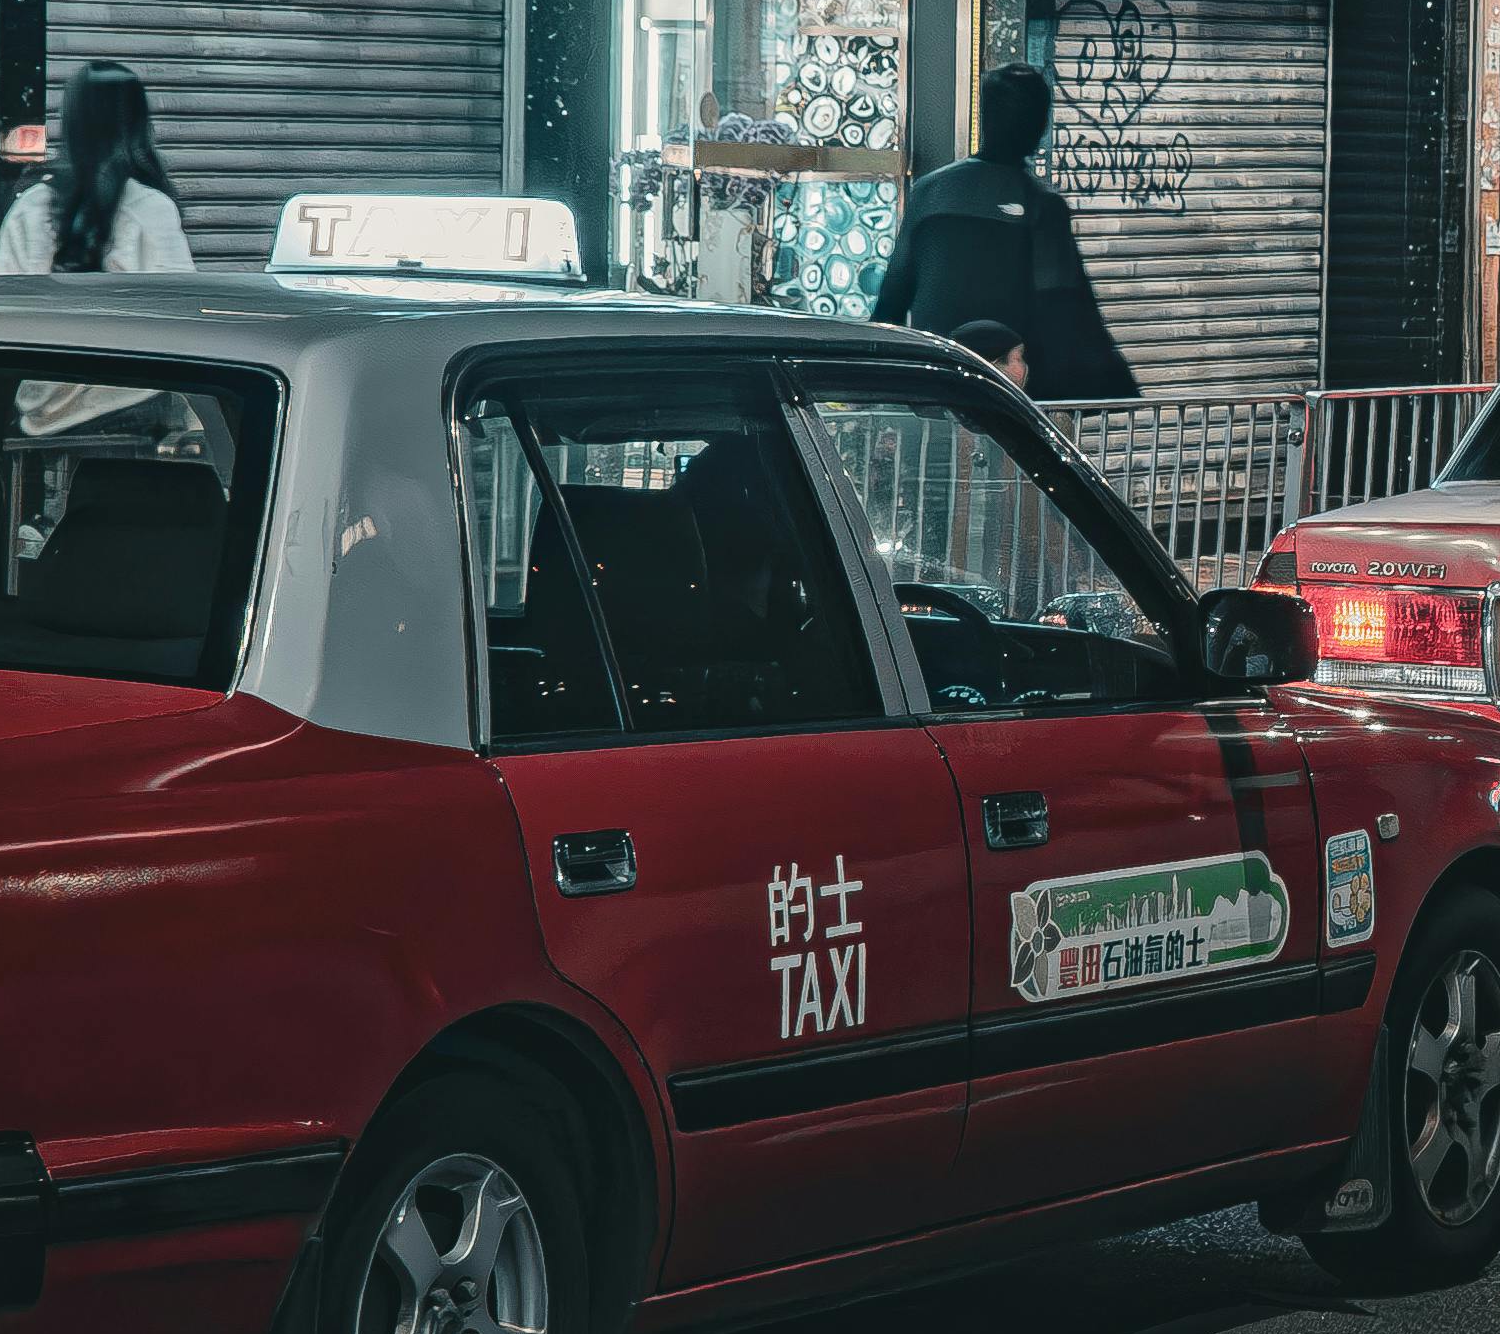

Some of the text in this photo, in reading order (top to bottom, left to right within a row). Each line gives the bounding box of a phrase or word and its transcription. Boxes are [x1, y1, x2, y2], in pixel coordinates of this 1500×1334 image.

[1308, 561, 1359, 576] TOYOTA
[767, 855, 866, 947] 的士
[769, 941, 867, 1039] TAXI
